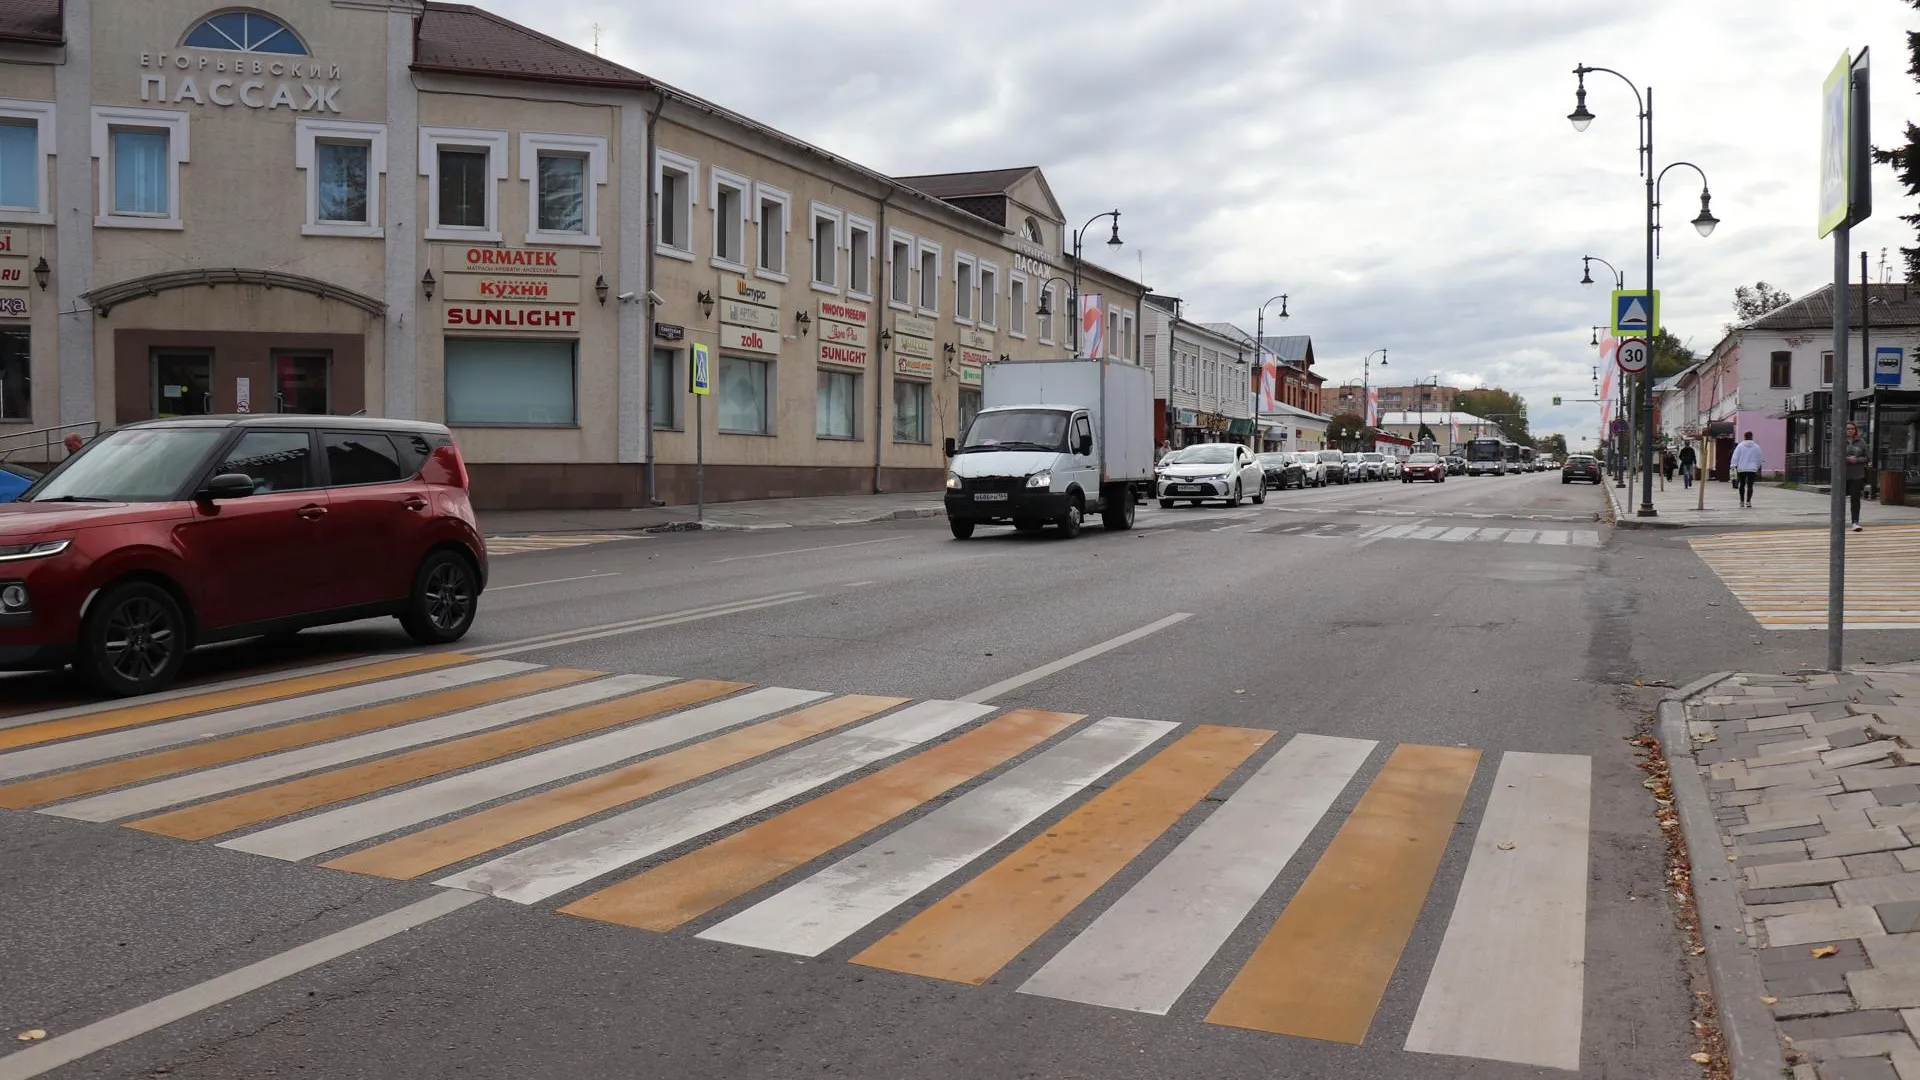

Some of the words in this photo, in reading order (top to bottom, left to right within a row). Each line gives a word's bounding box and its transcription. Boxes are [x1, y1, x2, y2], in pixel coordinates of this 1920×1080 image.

[140, 52, 342, 80] ЕГОРЬЕВСКИЙ
[140, 74, 342, 113] ПАССАЖ
[466, 248, 557, 266] ORMATEK
[1015, 253, 1051, 280] ПАССАЖ
[0, 298, 27, 315] ка
[822, 302, 845, 317] МНОГО
[447, 308, 576, 326] SUNLIGHT
[821, 346, 866, 364] SUNLIGHT
[1624, 348, 1643, 363] 30
